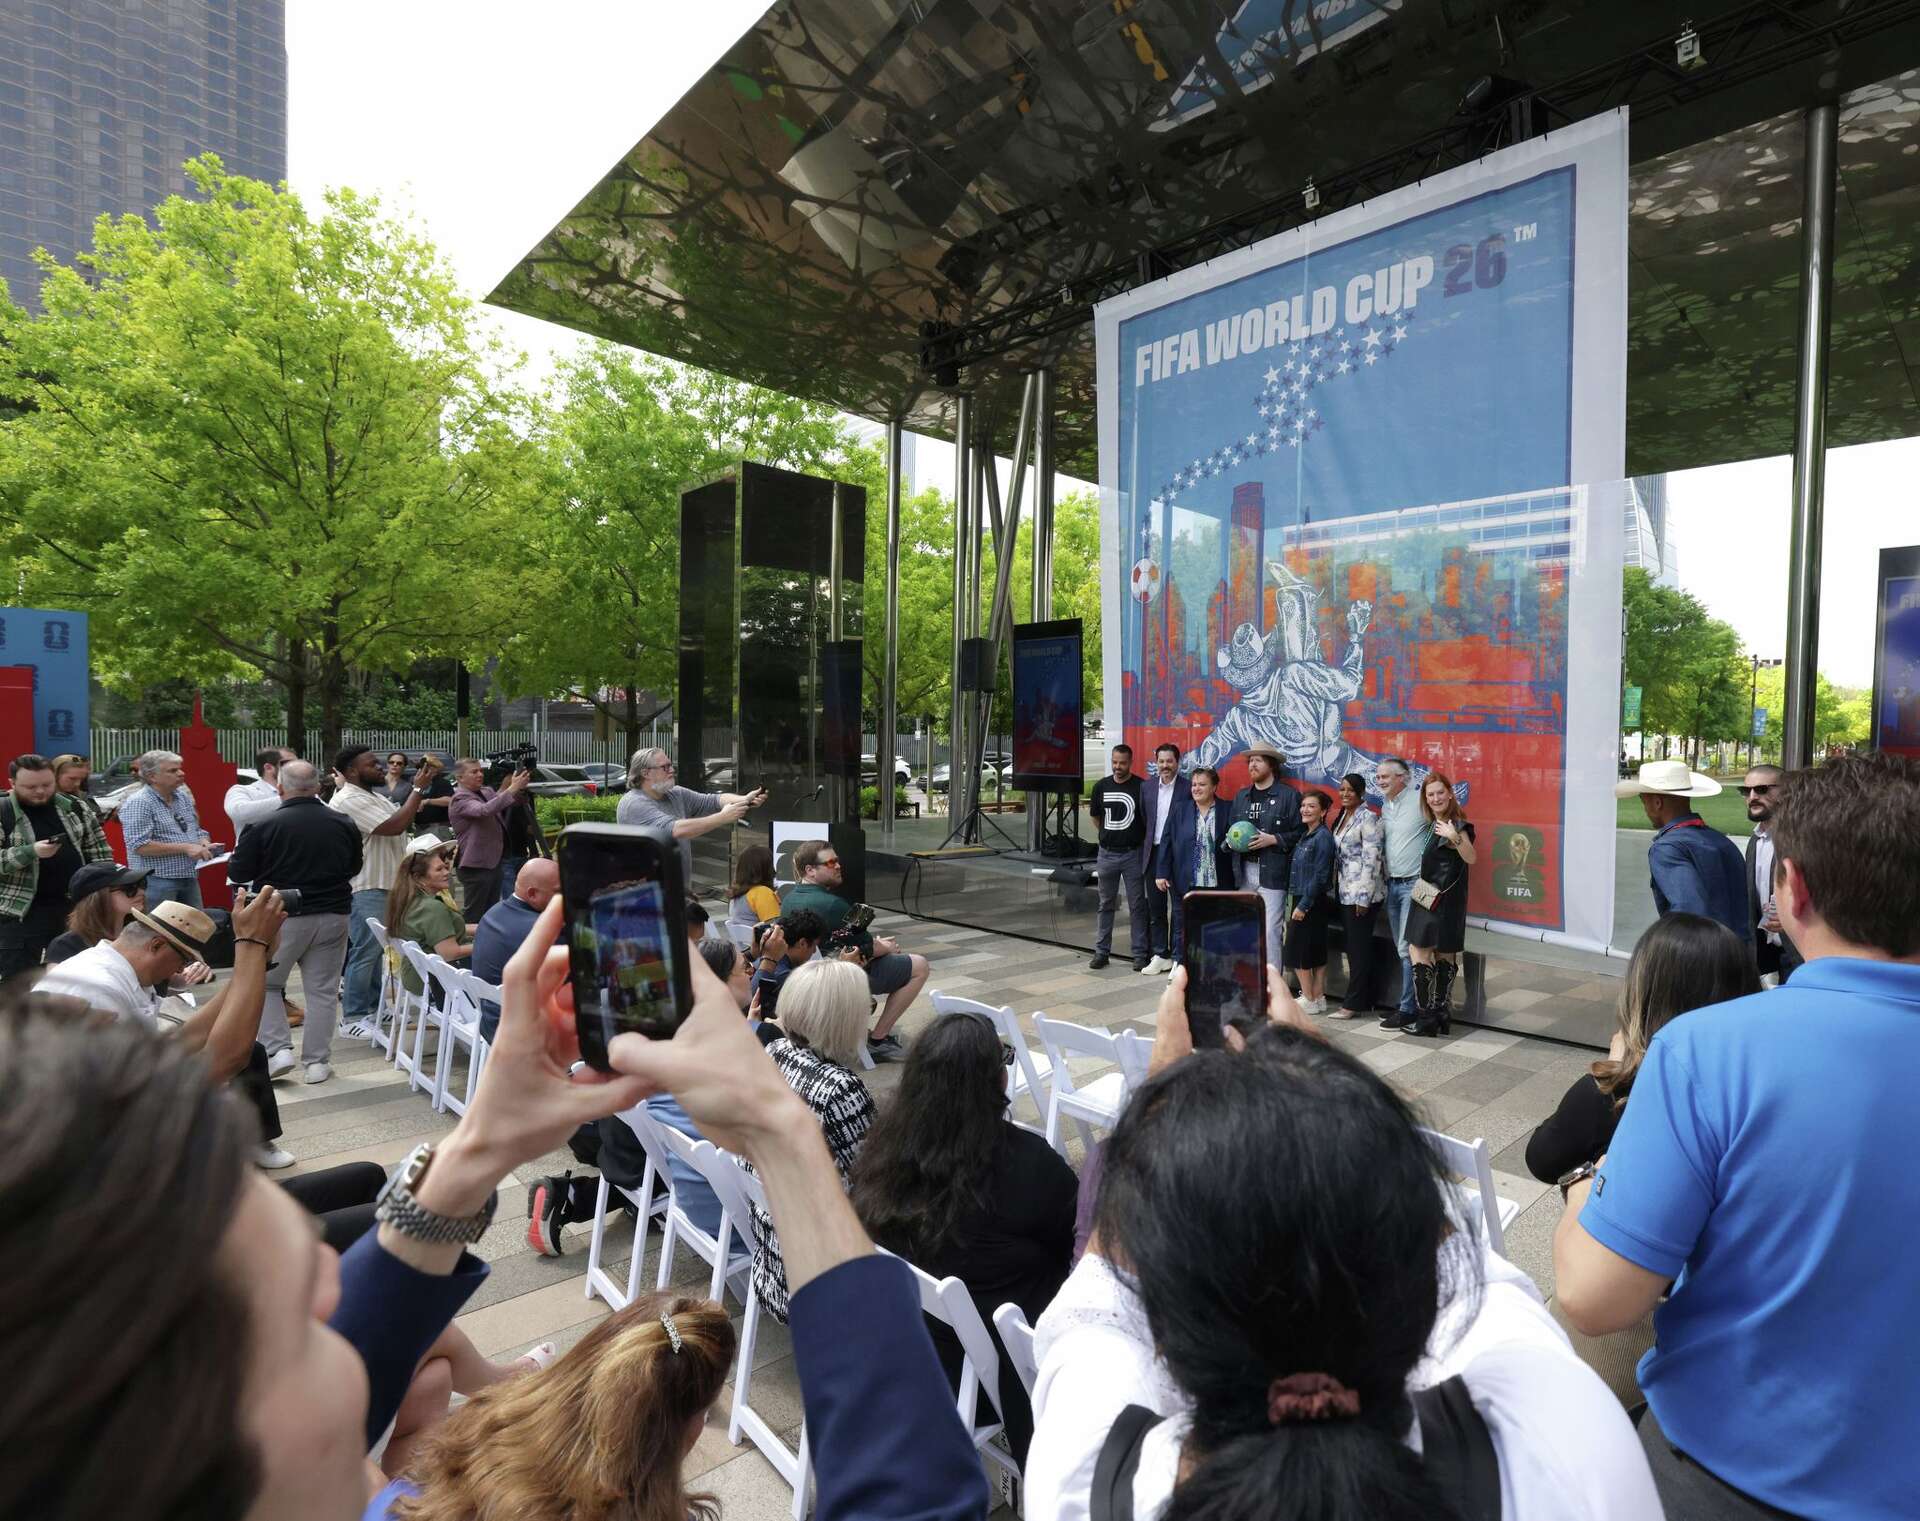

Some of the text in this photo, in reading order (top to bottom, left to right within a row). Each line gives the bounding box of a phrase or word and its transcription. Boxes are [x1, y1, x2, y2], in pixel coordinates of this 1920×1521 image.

[1136, 328, 1200, 387] FIFA
[1206, 286, 1337, 366] WORLD
[1345, 255, 1434, 324] CUP
[1443, 232, 1507, 298] 26
[1103, 792, 1136, 831] D
[1506, 887, 1532, 897] FIFA
